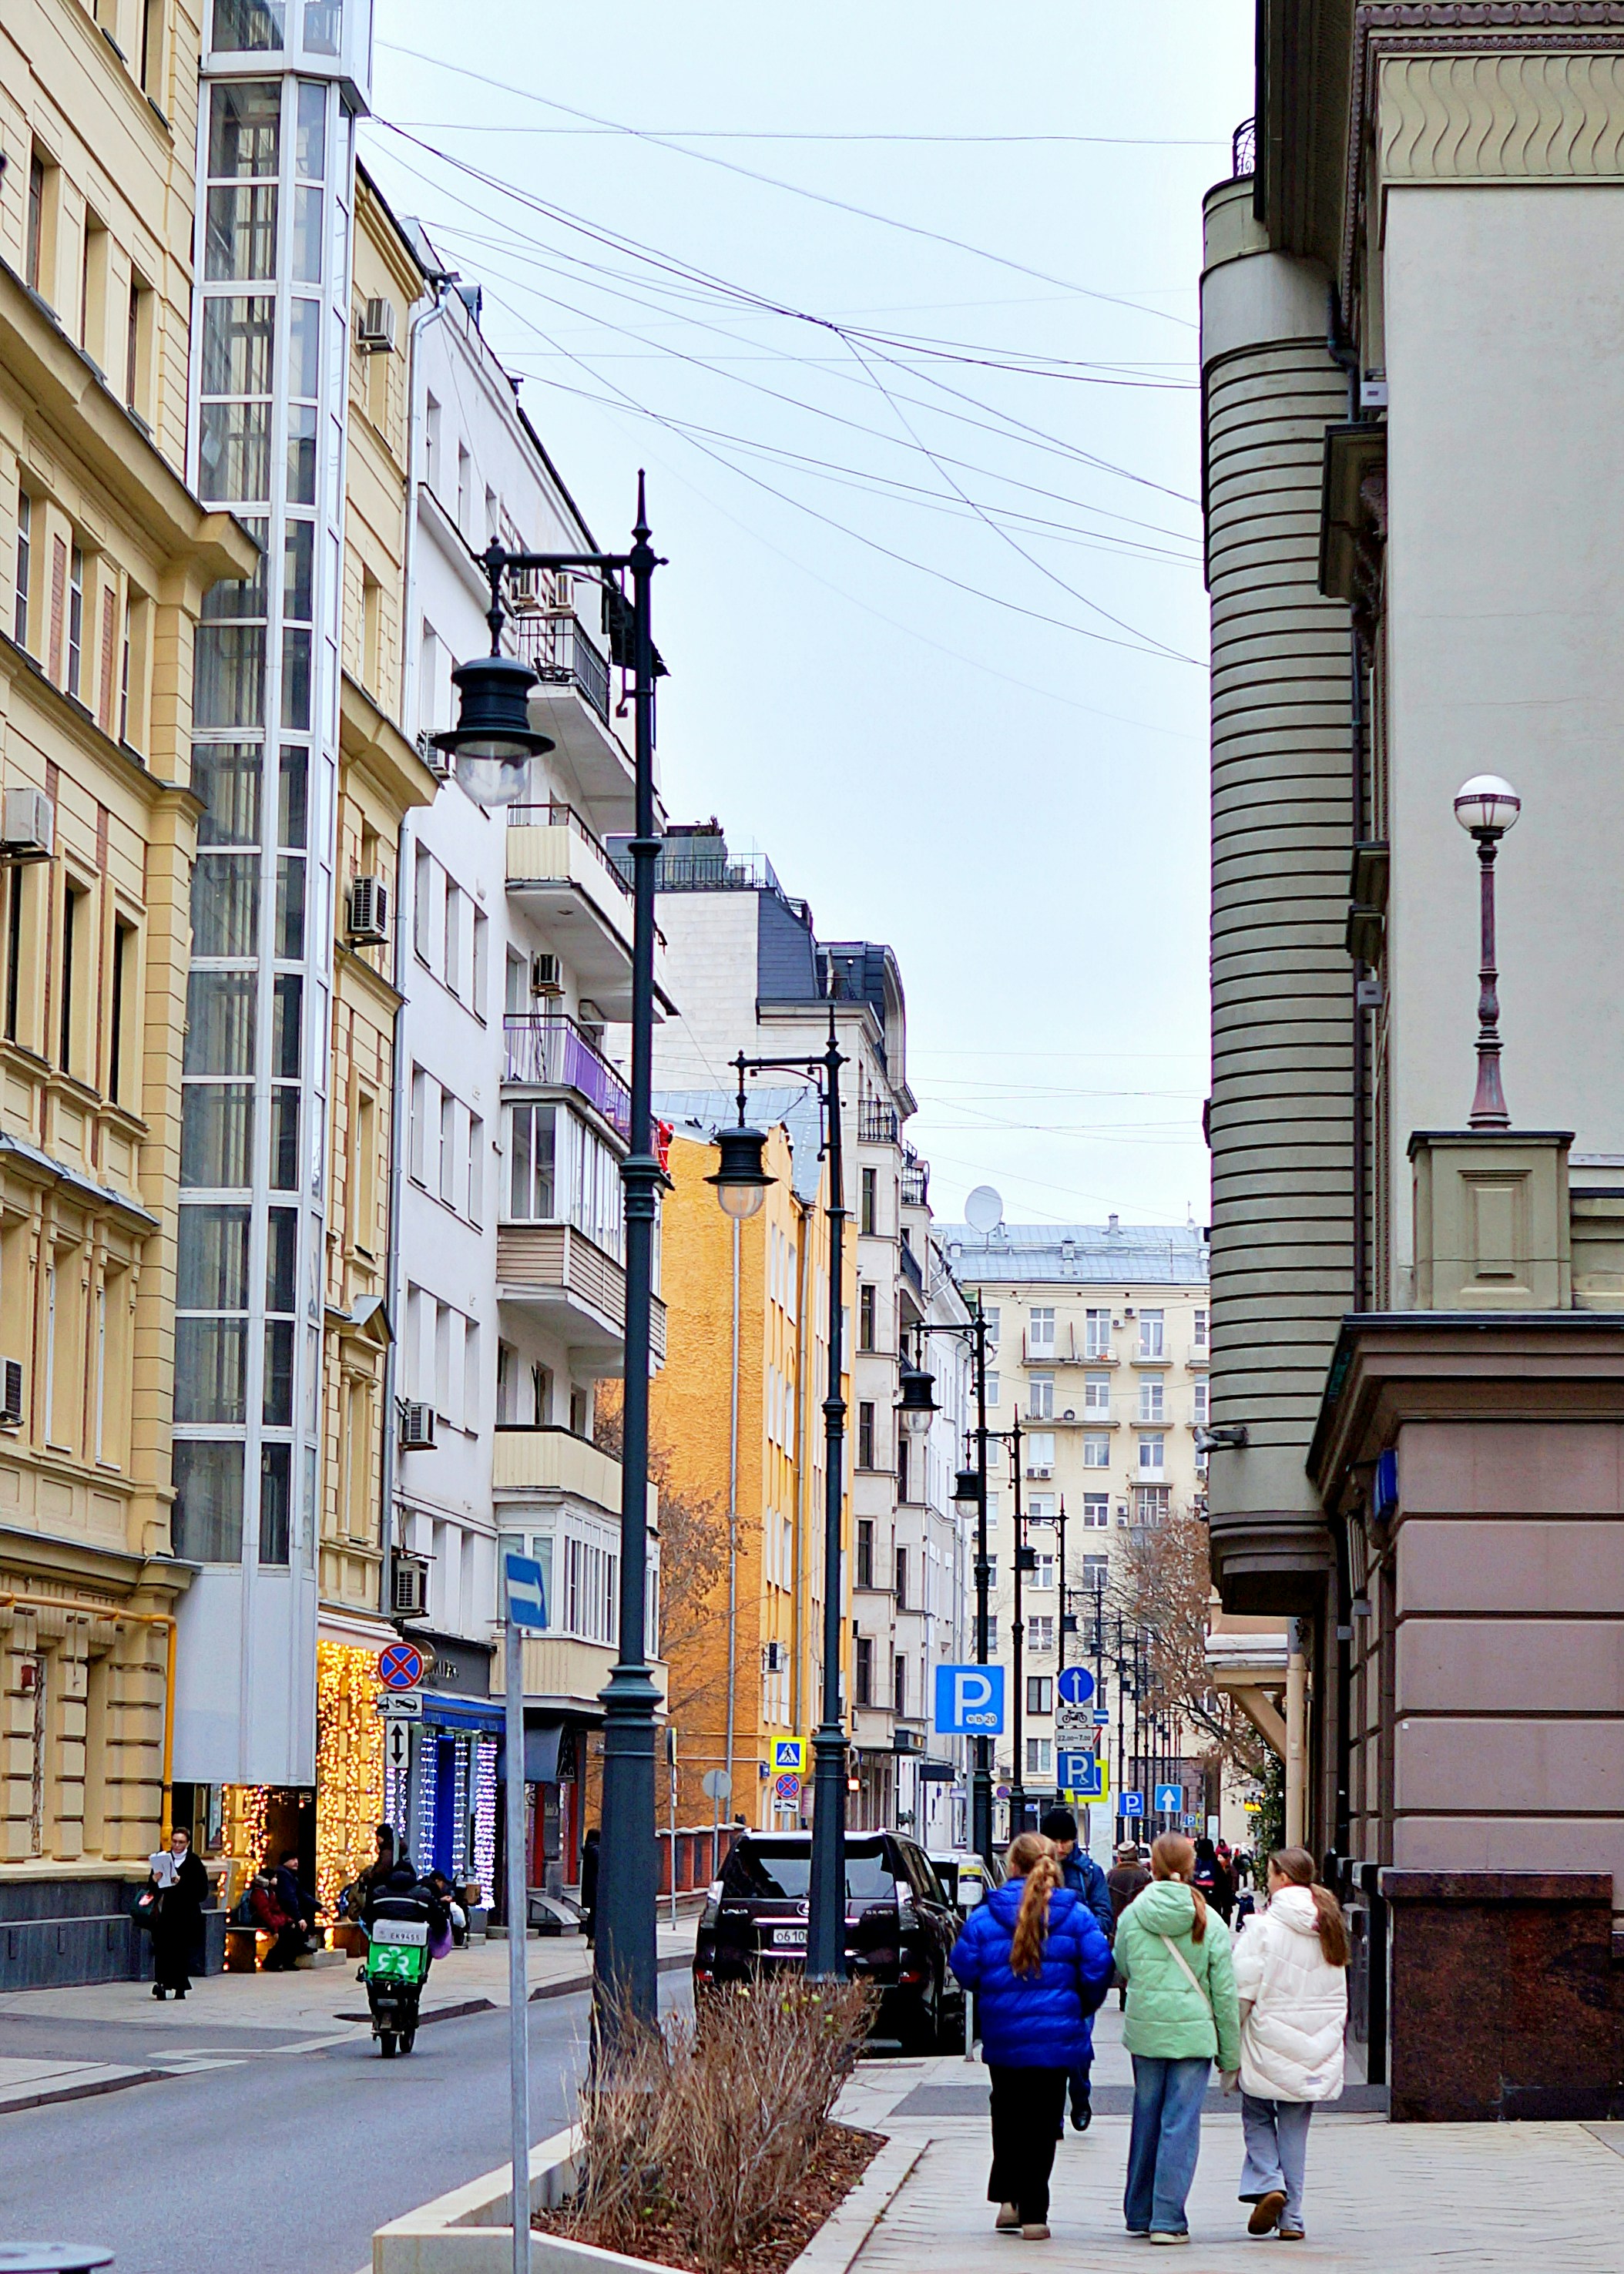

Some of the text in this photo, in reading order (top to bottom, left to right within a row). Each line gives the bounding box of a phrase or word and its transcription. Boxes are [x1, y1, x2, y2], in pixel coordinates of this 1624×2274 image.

[955, 1672, 992, 1726] P
[985, 1715, 996, 1723] 20
[1067, 1756, 1089, 1785] P
[1126, 1795, 1139, 1813] P
[1187, 1816, 1195, 1825] P
